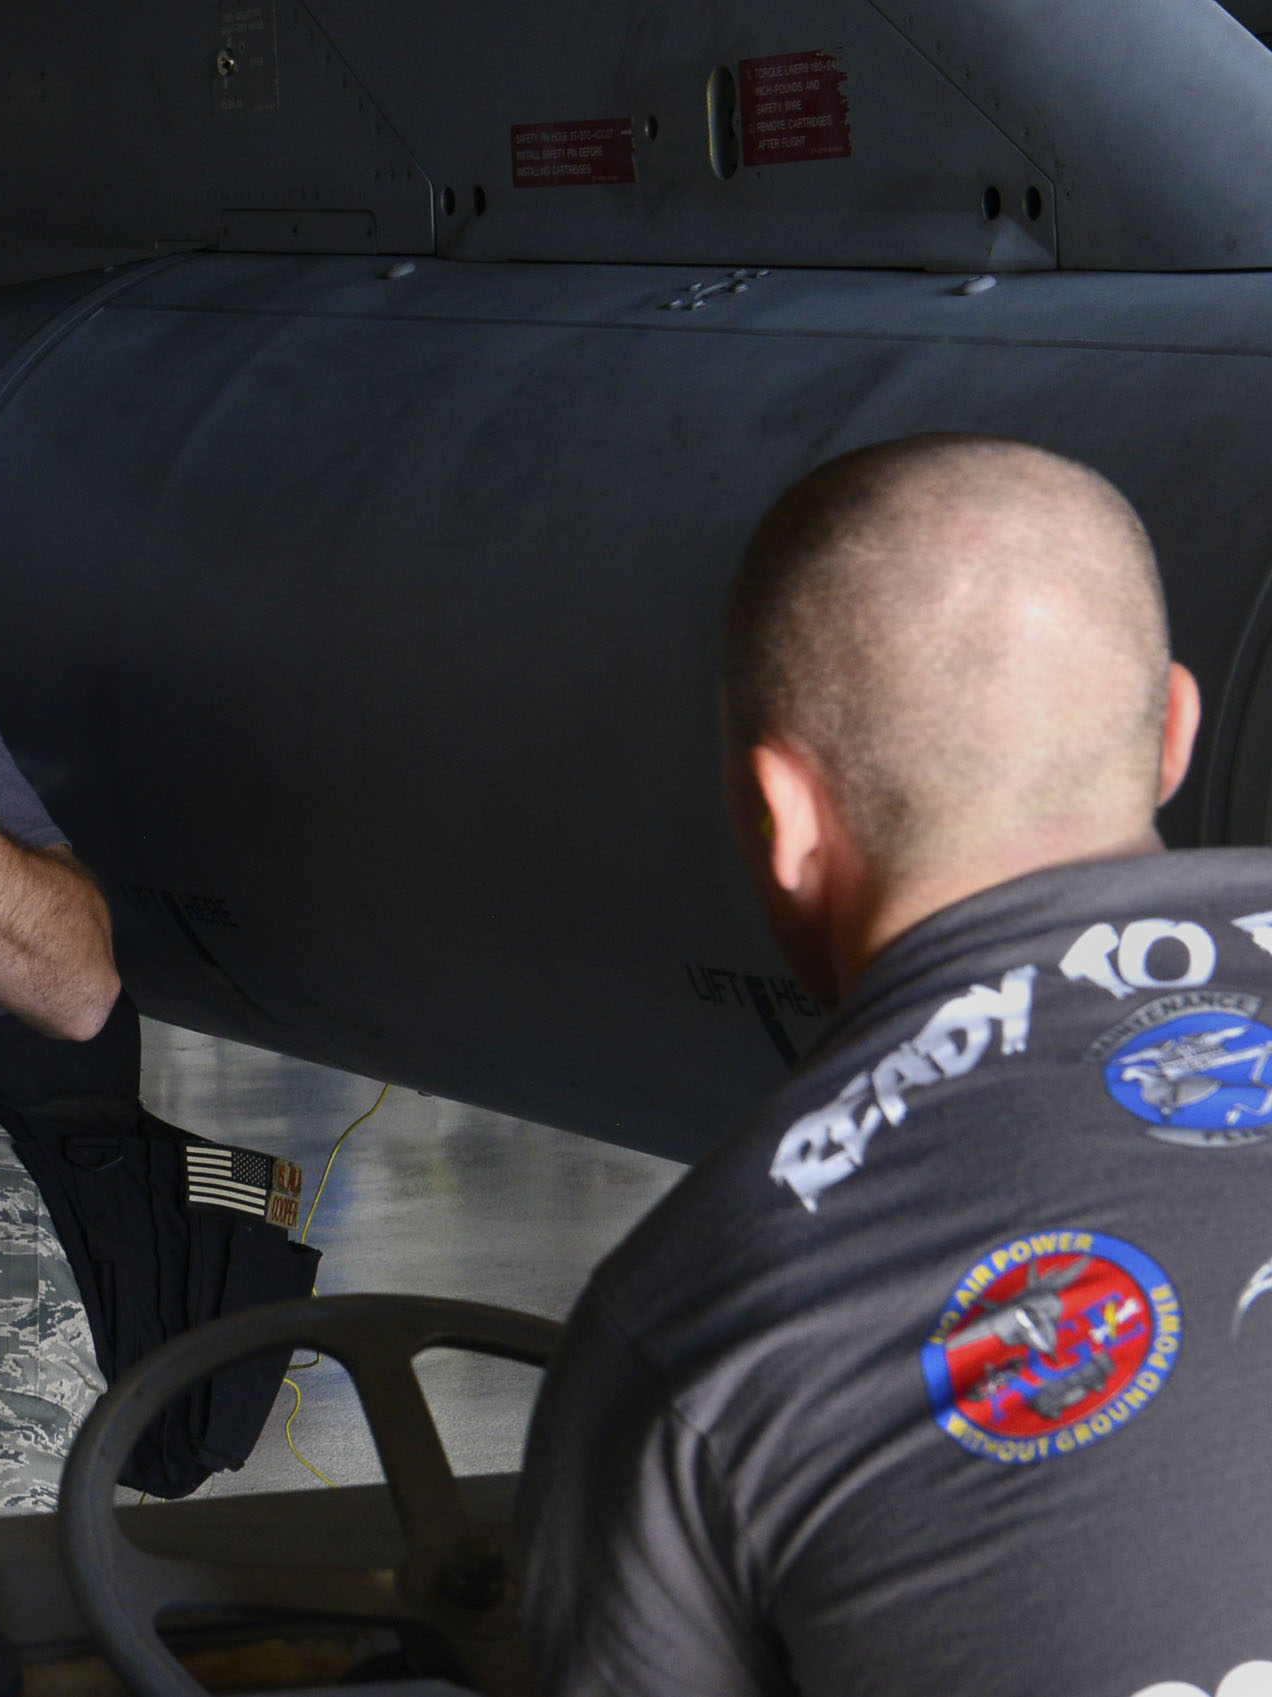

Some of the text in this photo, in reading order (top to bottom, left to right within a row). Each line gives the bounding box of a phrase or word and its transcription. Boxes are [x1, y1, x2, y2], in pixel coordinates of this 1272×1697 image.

[684, 965, 745, 1007] LIFT
[769, 918, 1218, 1214] READY TO
[954, 1263, 995, 1308] AIR
[990, 1231, 1095, 1272] POWER
[1055, 1370, 1161, 1453] GROUND
[1146, 1282, 1181, 1371] POWER
